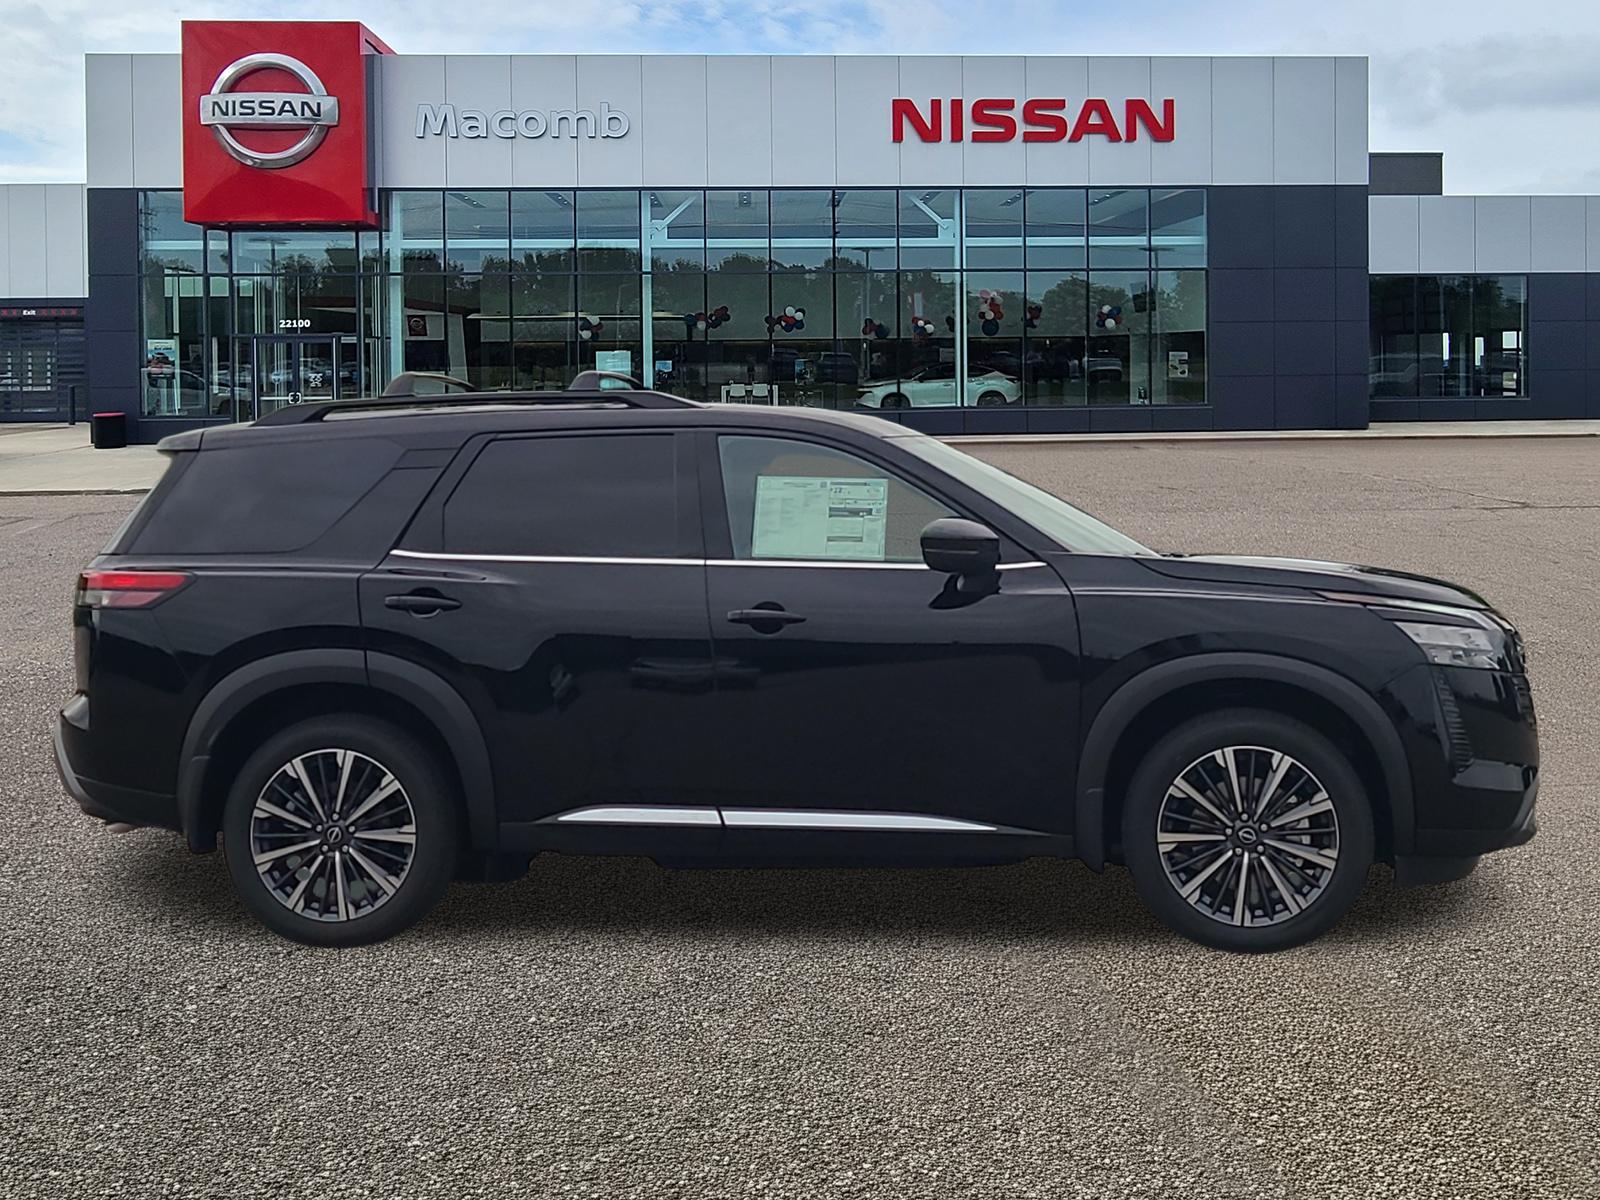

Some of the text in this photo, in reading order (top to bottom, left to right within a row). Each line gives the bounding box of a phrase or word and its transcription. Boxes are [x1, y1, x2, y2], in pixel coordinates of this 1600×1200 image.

[211, 100, 322, 118] NISSAN
[415, 102, 630, 138] Macomb
[891, 98, 1176, 143] NISSAN
[279, 319, 311, 328] 22100
